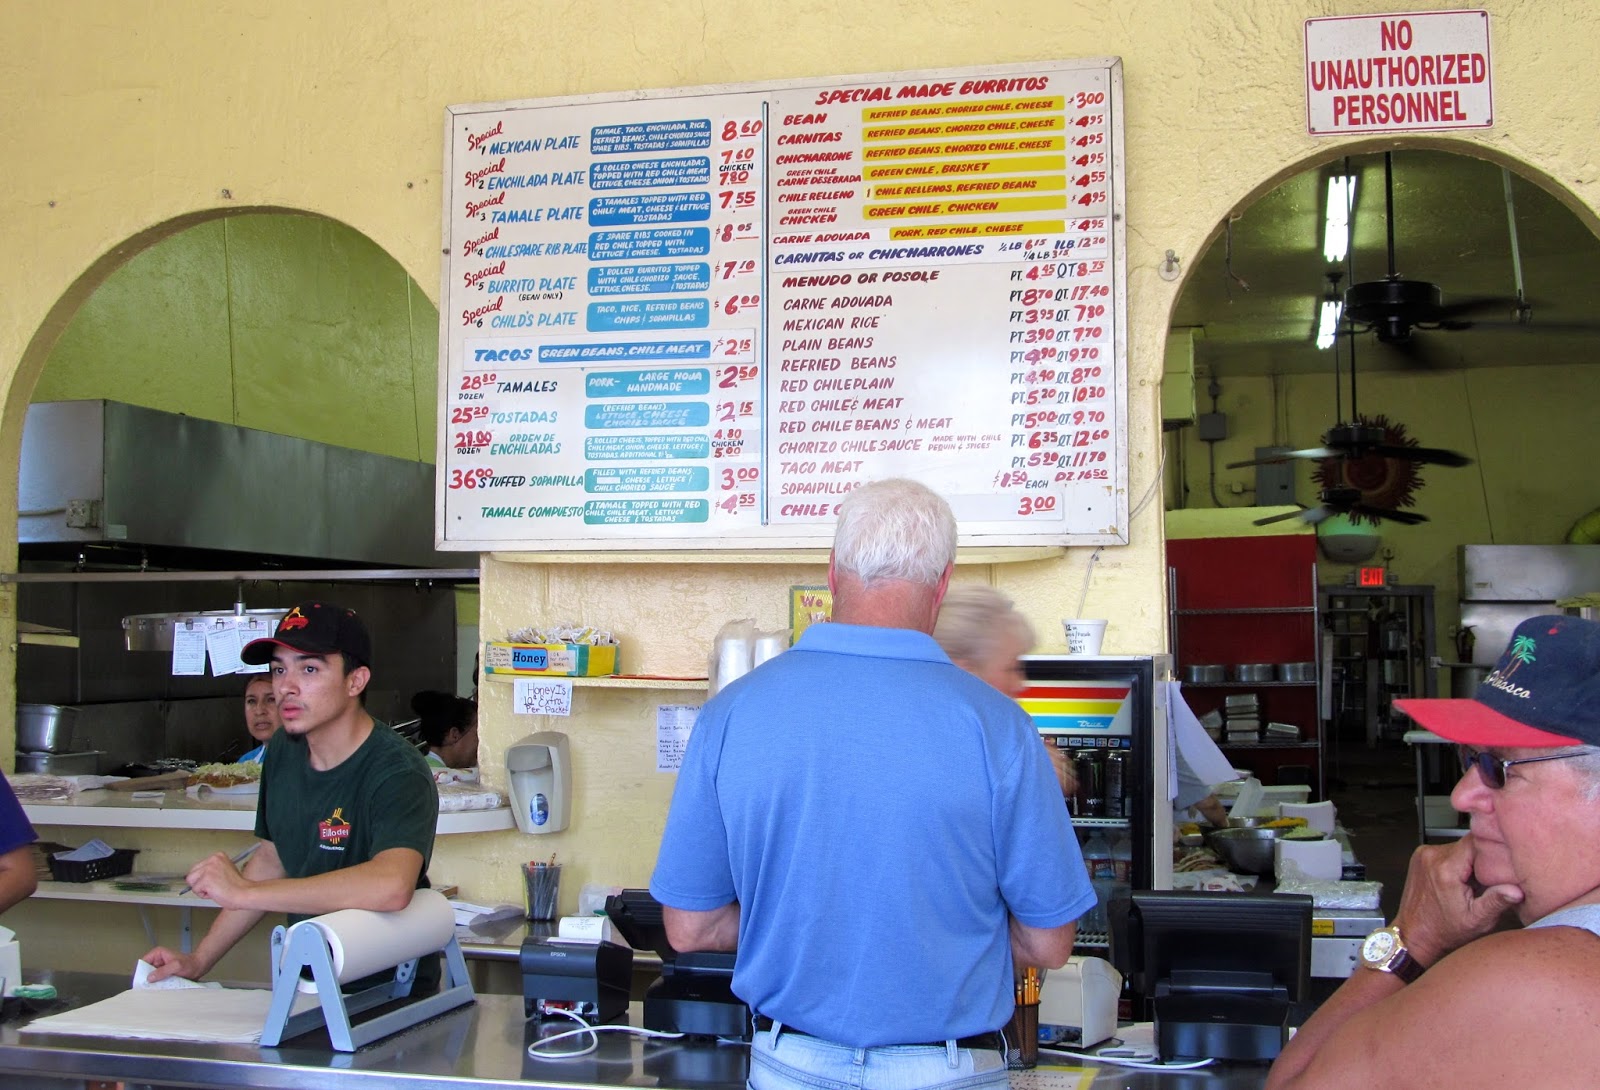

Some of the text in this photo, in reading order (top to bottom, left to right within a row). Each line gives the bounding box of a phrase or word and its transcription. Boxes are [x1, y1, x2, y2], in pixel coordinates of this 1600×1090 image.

[1380, 19, 1413, 51] NO
[1311, 53, 1486, 91] UNAUTHORIZED
[815, 75, 1049, 106] SPECIAL MADE BURRITOS
[870, 101, 1054, 119] REFRIED CHORIZO CHEESE
[1333, 90, 1467, 126] PERSONNEL
[783, 113, 827, 126] BEAN
[467, 120, 504, 151] Special
[868, 119, 1055, 138] REFRIED CHORIZO CHEESE
[489, 135, 581, 155] MEXICAN PLATE
[777, 131, 843, 145] CARNITAS
[866, 139, 1053, 158] REFRIED CHORIZO CHEESE
[603, 158, 706, 171] ROLLED CHEESE ENCHILADAS
[776, 151, 853, 165] CHICHARRONE
[465, 157, 506, 187] Special
[719, 163, 754, 172] CHICKEN
[786, 167, 837, 177] GREEN CHILE
[870, 162, 990, 178] GREEN BRISKET
[487, 170, 586, 190] ENCHILADA PLATE
[593, 171, 622, 180] TOPPED
[777, 174, 862, 187] CARNE DESEBRADA
[876, 180, 1037, 196] CHILE REFRIED BEANS
[604, 195, 639, 206] TAMALES
[778, 190, 854, 203] CHILE RELLENO
[465, 191, 505, 218] Special
[868, 202, 999, 217] GREEN CHICKEN
[491, 206, 584, 224] TAMALE PLATE
[633, 213, 672, 222] TOSTADAS
[779, 214, 837, 225] CHICKEN
[606, 229, 682, 240] SPARE RIBS COOKED
[985, 224, 1024, 233] CHEESE
[463, 226, 499, 256] Special
[773, 232, 870, 244] CARNE ADOVADA
[545, 242, 588, 255] RIB PLATE
[774, 244, 984, 265] CARNITAS OR CHICHARRONES
[464, 260, 506, 288] Special
[606, 265, 671, 275] ROLLED BURRITOS
[487, 276, 577, 293] BURRITO PLATE
[782, 270, 940, 288] MENUDO OR POSOLE
[645, 301, 705, 311] REFRIED BEANS
[783, 295, 893, 311] CARNE ADOVADA
[462, 295, 503, 326] Special
[490, 310, 578, 328] CHILD'S PLATE
[614, 314, 641, 323] CHIPS
[783, 316, 880, 331] MEXICAN RICE
[540, 343, 704, 358] GREEN CHILE MEAT
[782, 337, 874, 352] PLAIN BEANS
[474, 348, 533, 361] TACOS
[781, 356, 897, 372] REFRIED BEANS
[638, 371, 703, 382] LARGE HOJA
[497, 380, 558, 393] TAMALES
[626, 382, 683, 393] HANDMADE
[780, 377, 895, 393] RED CHILE PLAIN
[779, 397, 904, 413] RED MEAT
[490, 411, 558, 424] TOSTADAS
[779, 417, 953, 434] RED CHILE BEANS MEAT
[509, 433, 556, 442] ORDEN DE
[711, 440, 744, 448] CHICKEN
[981, 434, 1002, 442] CHILE
[490, 442, 562, 455] ENCHILADAS
[779, 438, 923, 454] CHORIZO CHILE SAUCE
[780, 460, 864, 474] TACO MEAT
[478, 475, 584, 488] STUFFED SOPAIPILLA
[615, 483, 675, 492] CHORIZO SAUCE
[1025, 480, 1049, 489] EACH
[481, 506, 584, 518] TAMALE COMPUESTO
[631, 501, 659, 509] TOPPED
[780, 503, 829, 516] CHILE
[604, 515, 630, 523] CHEESE
[1361, 567, 1384, 586] EXIT
[512, 651, 546, 667] Honey
[527, 683, 555, 697] Honey
[538, 695, 564, 707] Extra
[526, 705, 569, 714] Per Packet
